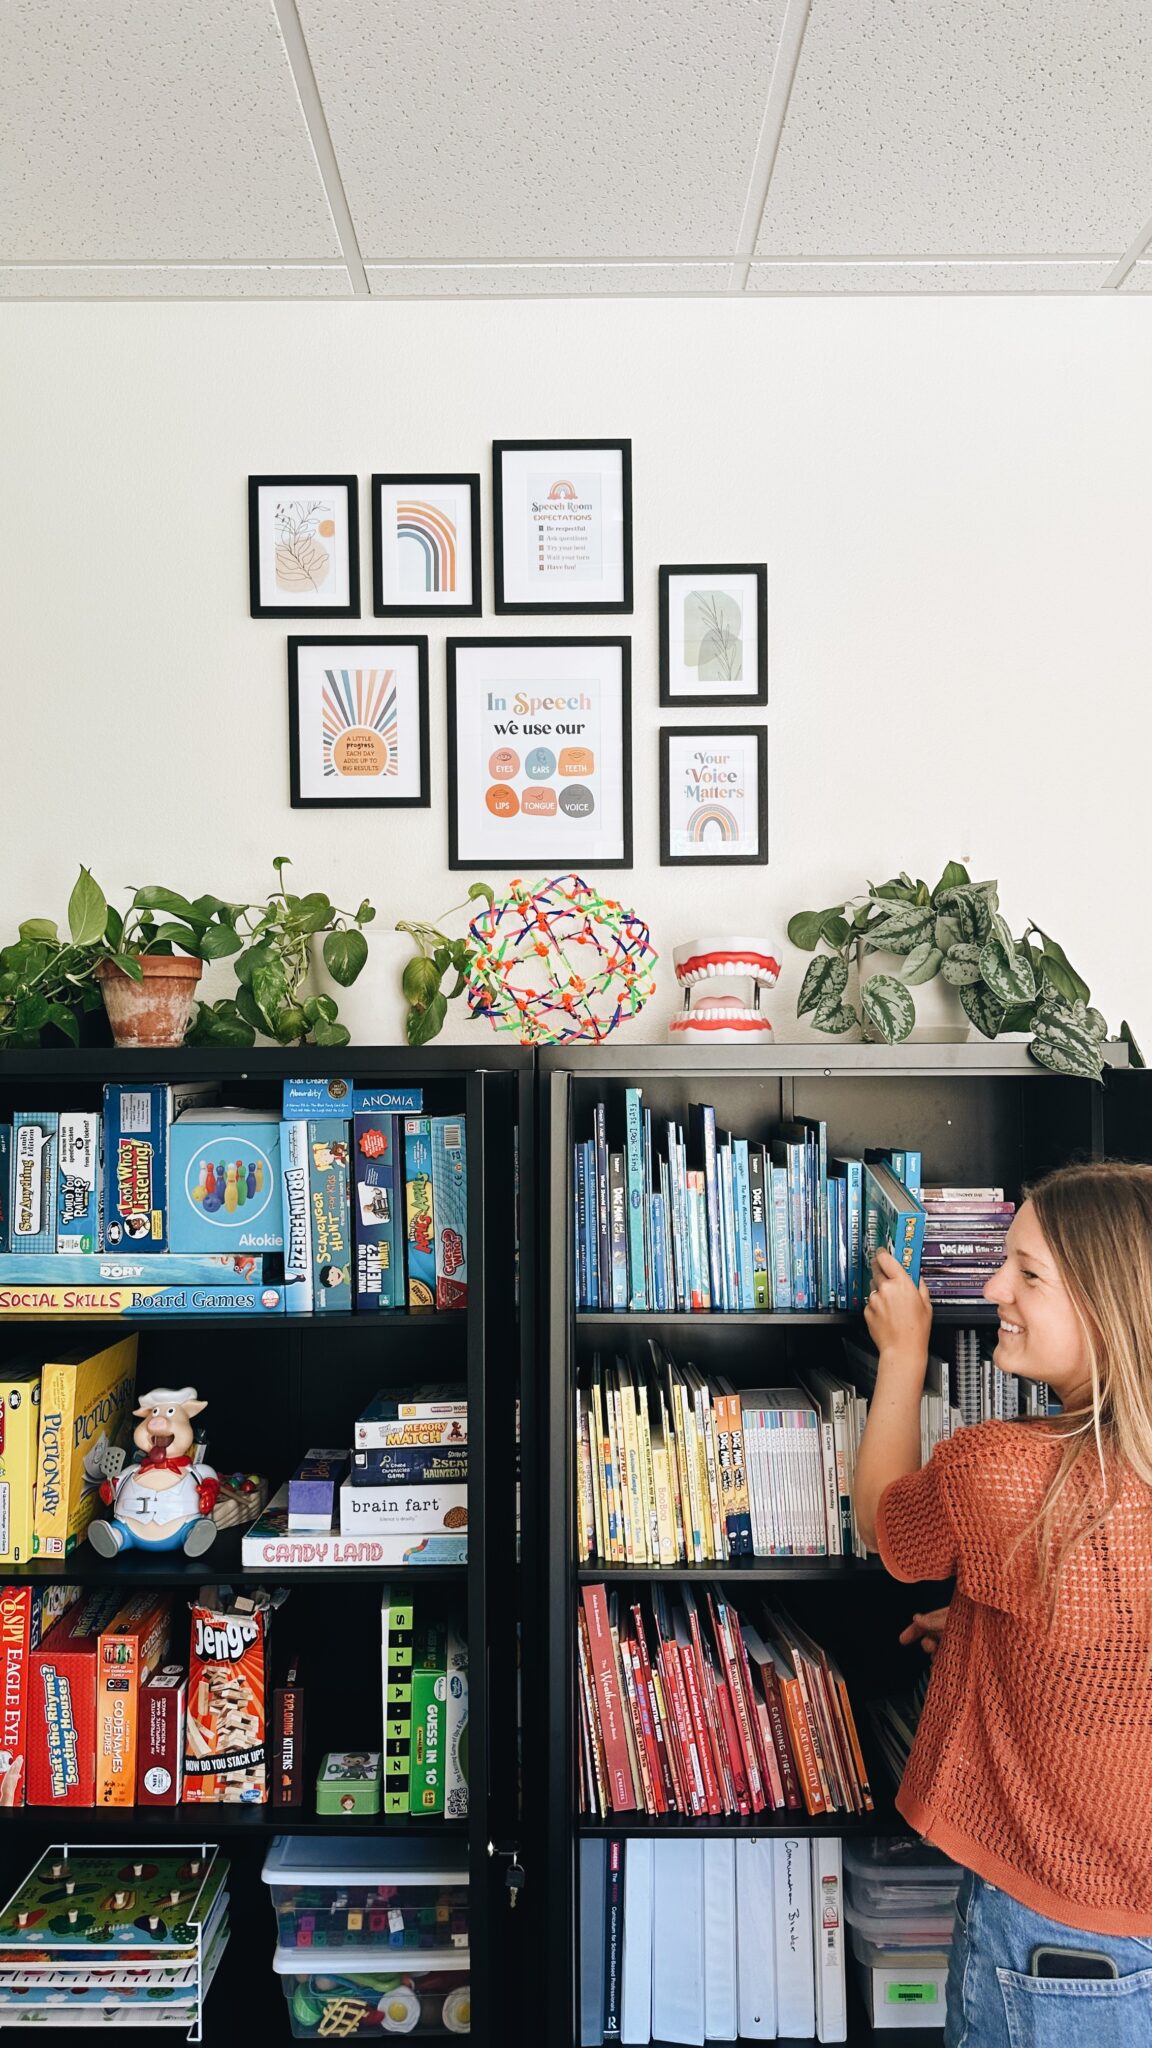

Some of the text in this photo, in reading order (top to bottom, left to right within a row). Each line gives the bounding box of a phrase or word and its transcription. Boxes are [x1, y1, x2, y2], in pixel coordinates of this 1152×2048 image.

[532, 501, 592, 512] Speech Room
[487, 692, 592, 716] In Speech
[494, 720, 586, 735] we use our
[496, 765, 513, 773] EYES
[532, 766, 549, 774] EARS
[565, 765, 587, 773] TEETH
[685, 765, 738, 783] Voice
[694, 752, 731, 764] Your
[495, 802, 510, 810] LIPS
[525, 802, 556, 810] TONGUE
[565, 803, 589, 811] VOICE
[684, 785, 745, 802] Matters
[362, 1094, 414, 1108] ANOMIA
[27, 1129, 35, 1158] Edition
[61, 1175, 75, 1193] YOU
[117, 1144, 133, 1211] Look Who's
[131, 1139, 154, 1214] Listening!
[18, 1159, 34, 1232] Say Anything
[62, 1193, 75, 1225] WOULD
[74, 1177, 90, 1217] RATHER?
[612, 1187, 624, 1223] DOG MAN
[752, 1187, 763, 1223] DOG MAN
[312, 1191, 332, 1264] SCAVENGER
[328, 1211, 345, 1252] HUNT
[851, 1167, 859, 1269] COLLINS MOCKINGJAY
[239, 1233, 283, 1247] Akokie
[378, 1241, 390, 1270] FAMILY
[775, 1205, 788, 1278] Little Women
[939, 1244, 974, 1255] DOG MAN
[100, 1265, 145, 1278] DORY
[358, 1244, 367, 1293] WHAT DO YOU
[366, 1244, 382, 1293] MEME?
[444, 1242, 454, 1274] Guess
[0, 1292, 59, 1308] SOCIAL
[64, 1291, 121, 1308] SKILLS
[131, 1293, 186, 1308] Board
[192, 1293, 256, 1308] Games
[74, 1377, 135, 1449] PICTIONARY
[403, 1422, 448, 1434] MEMORY
[386, 1432, 441, 1447] MATCH
[718, 1431, 731, 1468] DOG MAN
[730, 1430, 743, 1467] DOG MAN
[42, 1412, 62, 1516] PICTIONARY
[423, 1469, 460, 1479] HAUNTED
[629, 1449, 638, 1495] Curious George
[836, 1450, 846, 1494] HOP POP
[352, 1498, 440, 1513] brain fart
[658, 1487, 669, 1521] BooBoo
[828, 1489, 836, 1510] Monday
[262, 1542, 384, 1563] CANDY LAND
[195, 1619, 258, 1660] Jenga
[3, 1615, 25, 1746] SPY EAGLE EYE
[683, 1648, 704, 1730] Socially Curious Curiously Social
[649, 1691, 660, 1730] ESSENTIAL
[673, 1701, 687, 1741] MAGICAL FEELINGS
[730, 1665, 750, 1742] DAVID GETS IN TROUBLE
[764, 1666, 792, 1775] COLLINS CATCHING FIRE
[42, 1666, 65, 1796] What's the Rhyme?
[56, 1678, 77, 1785] Sorting Houses
[103, 1715, 113, 1756] PICTURES
[112, 1699, 124, 1773] CODENAMES
[282, 1693, 295, 1770] EXPLODING KITTENS
[426, 1704, 438, 1785] GUESS IN 10
[599, 1668, 626, 1801] Weather PRESTEL
[634, 1722, 642, 1738] Eggs
[654, 1730, 664, 1743] GUIDE
[185, 1748, 264, 1771] HOW DO YOU STACK UP?
[450, 1756, 460, 1774] Exciting
[799, 1727, 818, 1787] CAT IN THE CITY
[788, 1908, 800, 1952] Binder
[609, 1977, 617, 2012] Professionals
